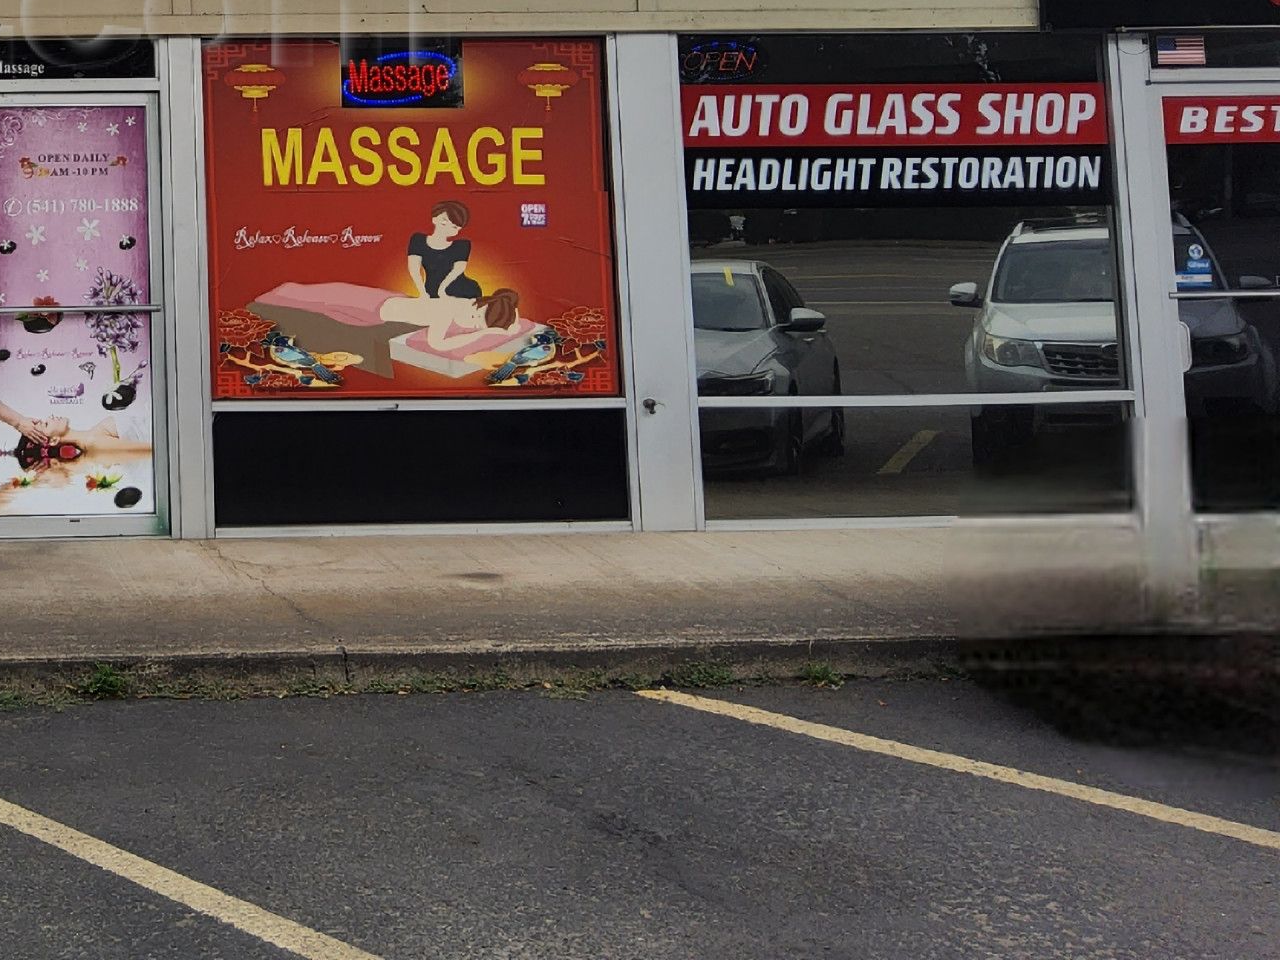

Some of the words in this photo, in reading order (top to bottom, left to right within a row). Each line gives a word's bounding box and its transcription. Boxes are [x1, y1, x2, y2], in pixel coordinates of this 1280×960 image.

[348, 58, 450, 97] Massage
[684, 51, 758, 71] OPEN
[689, 93, 809, 137] AUTO
[823, 92, 961, 135] GLASS
[976, 92, 1097, 134] SHOP
[38, 154, 70, 163] OPEN
[73, 153, 110, 163] DAILY
[261, 126, 546, 187] MASSAGE
[692, 157, 876, 191] HEADLIGHT
[880, 155, 1102, 189] RESTORATION
[26, 199, 65, 215] (541)
[70, 198, 138, 212] 780-1888
